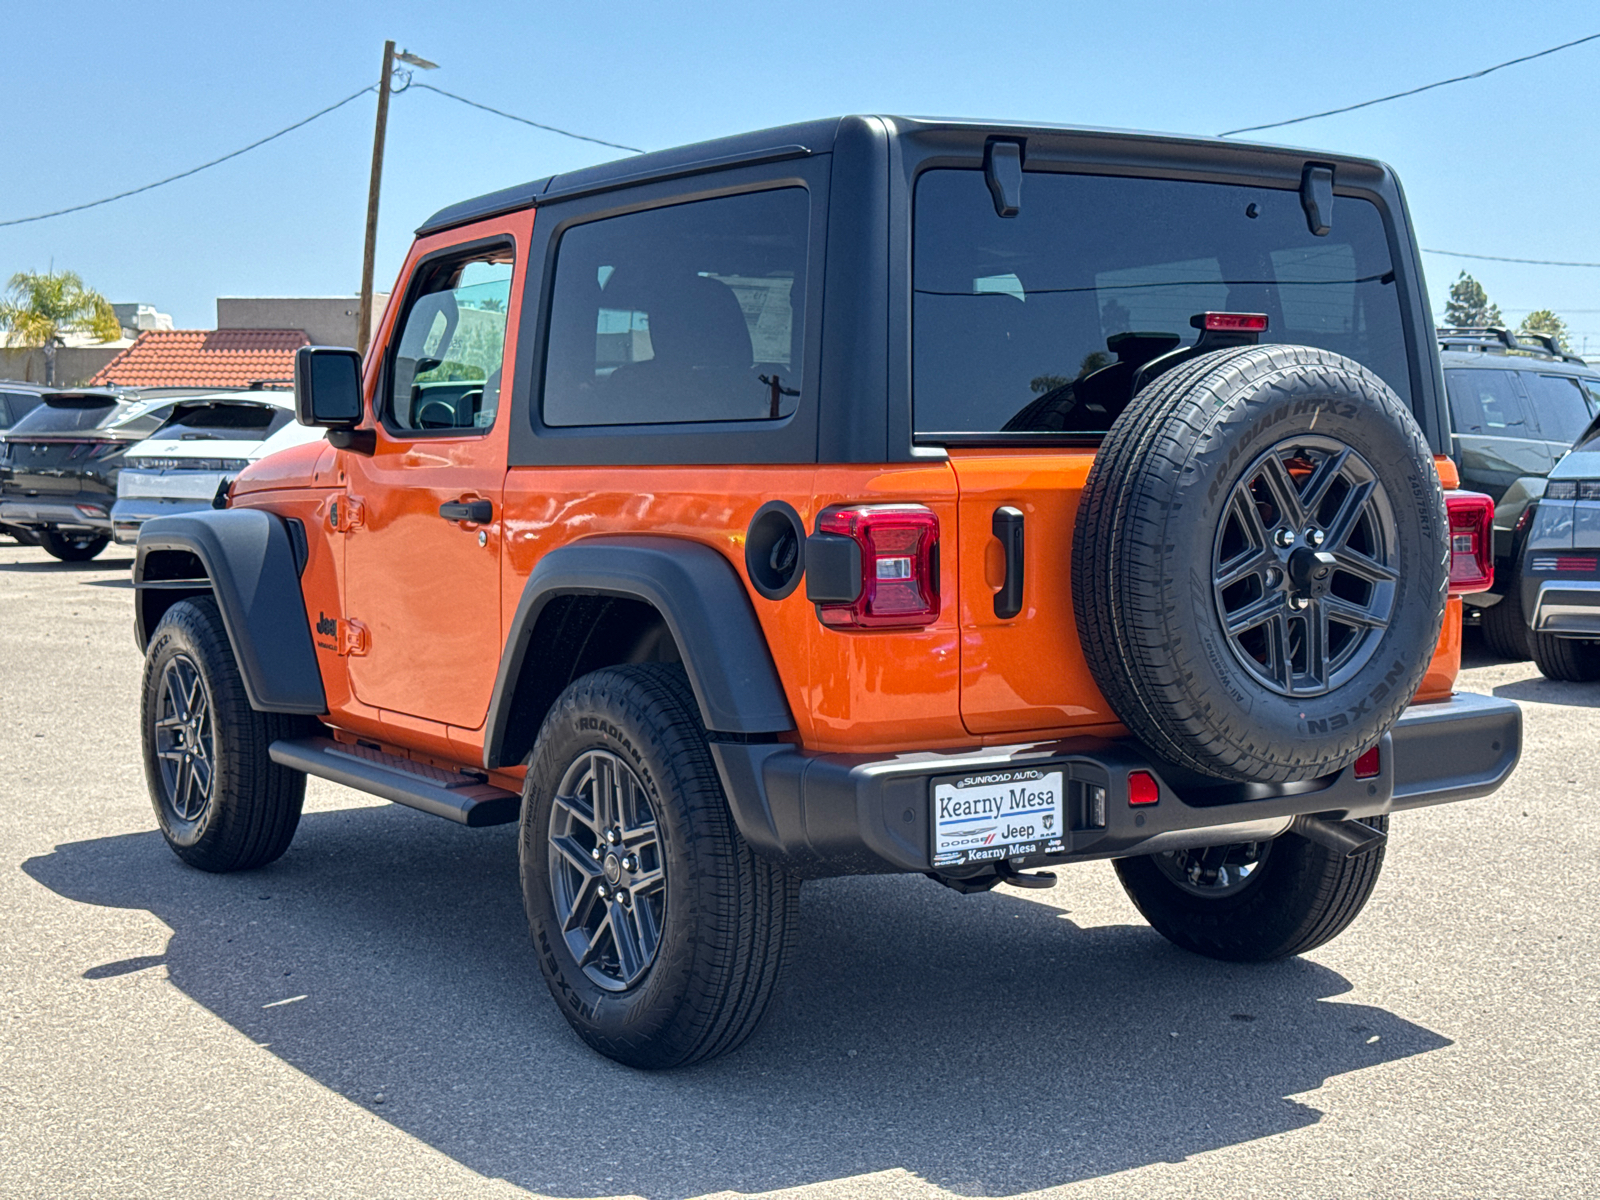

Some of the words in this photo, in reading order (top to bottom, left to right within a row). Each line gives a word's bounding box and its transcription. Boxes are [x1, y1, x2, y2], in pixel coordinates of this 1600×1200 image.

[1208, 404, 1289, 506] ROADIAN
[1293, 399, 1358, 419] HTX2
[1407, 474, 1431, 539] 245/75R17
[1204, 637, 1244, 702] All-Weather
[1307, 660, 1405, 734] NEXEN
[580, 718, 642, 765] ROADIAN
[964, 773, 1011, 786] SUNROAD
[1013, 770, 1038, 780] AUTO
[939, 796, 1004, 819] Kearny
[1009, 788, 1055, 810] Mesa
[941, 837, 988, 848] DODGE
[968, 847, 1006, 861] Kearny
[1009, 843, 1036, 856] Mesa
[1001, 824, 1035, 839] Jeep
[538, 931, 595, 1019] NEXEN
